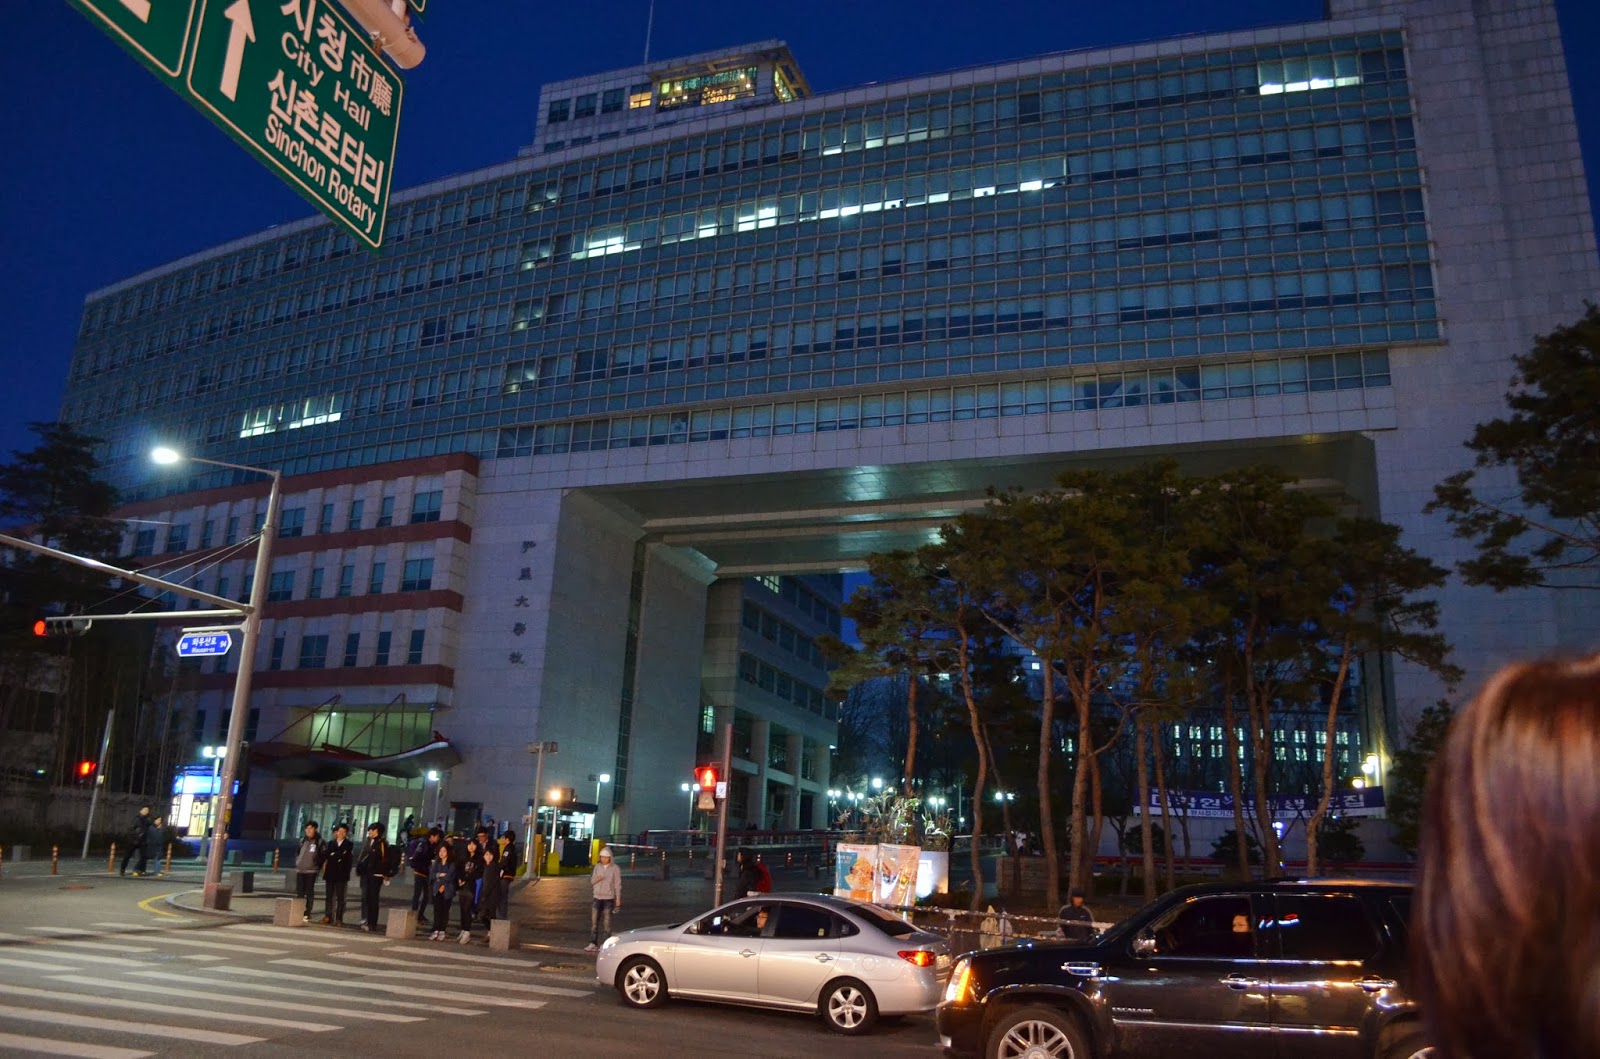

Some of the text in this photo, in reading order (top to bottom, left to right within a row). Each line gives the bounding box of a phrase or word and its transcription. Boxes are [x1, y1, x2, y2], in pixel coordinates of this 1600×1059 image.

[281, 0, 347, 72] 시청
[281, 32, 371, 131] City Hall
[265, 114, 377, 234] Sinchon Rotary
[268, 69, 384, 205] 신촌로터리
